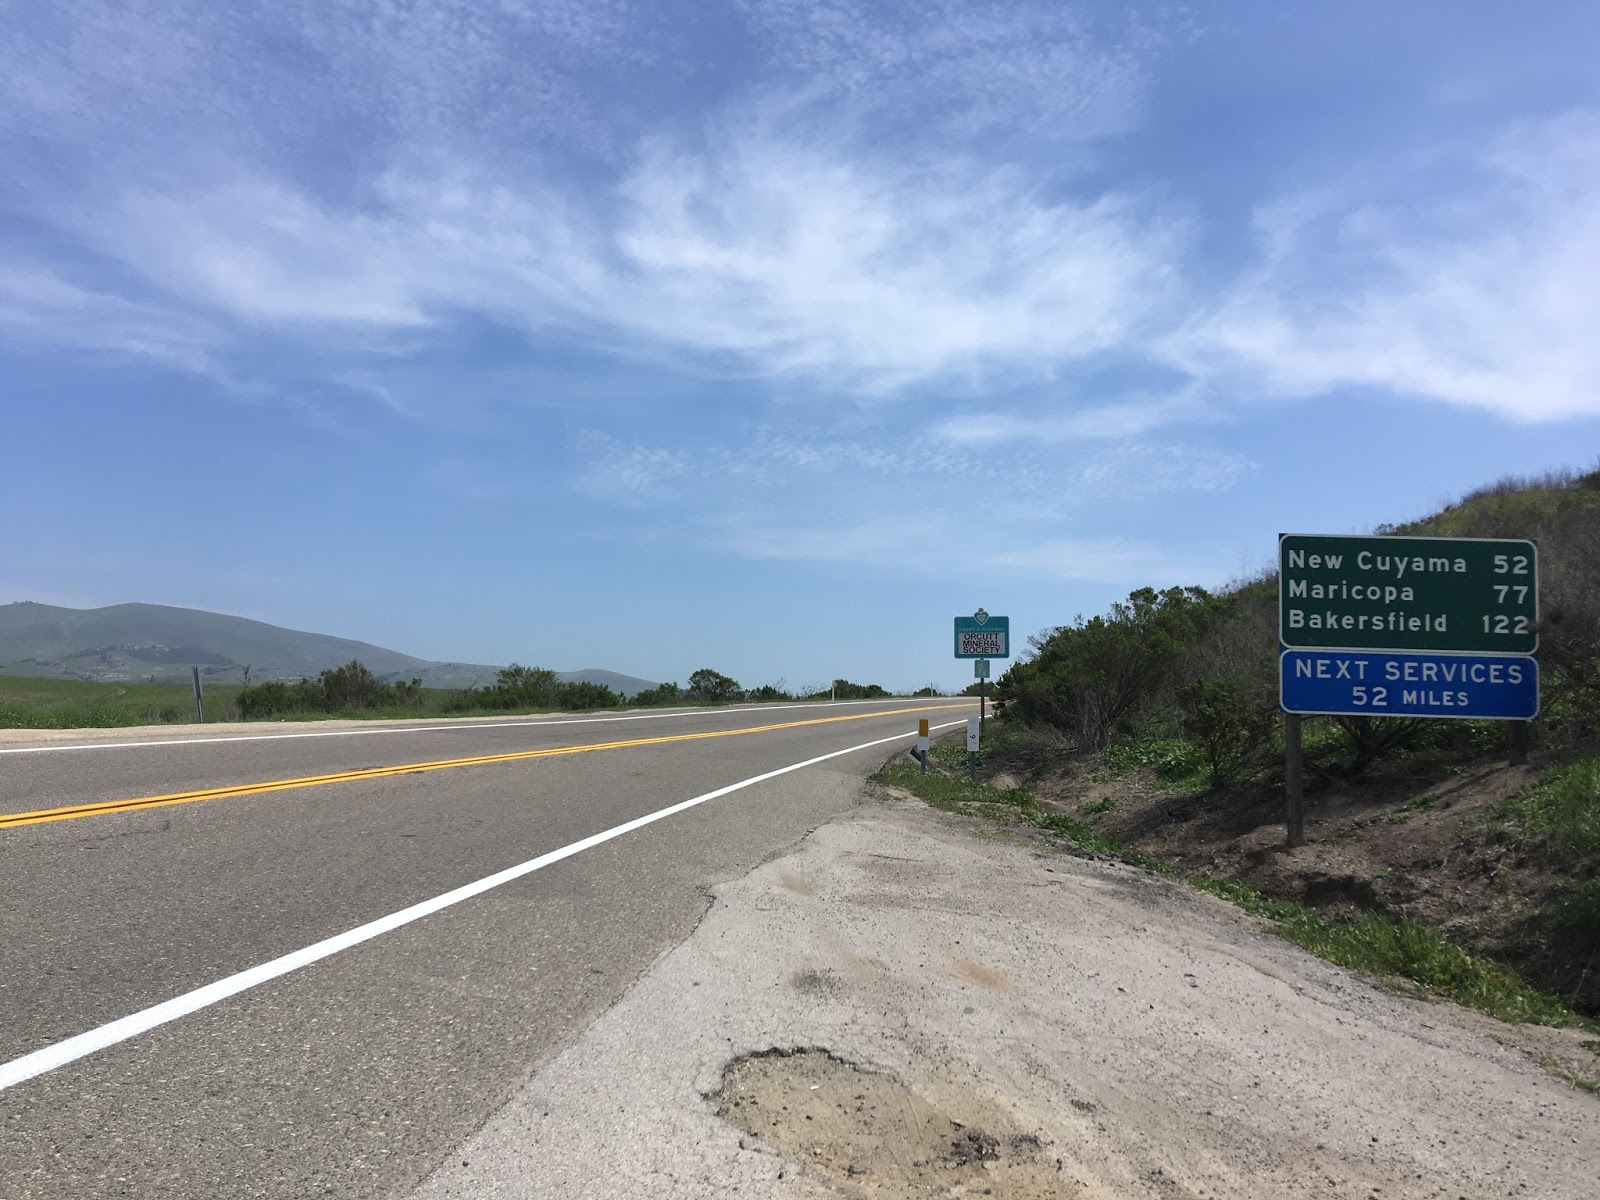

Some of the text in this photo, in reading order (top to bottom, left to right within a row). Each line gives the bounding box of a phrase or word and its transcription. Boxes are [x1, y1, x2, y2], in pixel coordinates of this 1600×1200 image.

[1288, 549, 1529, 578] New Cuyama 52
[1288, 579, 1529, 604] Maricopa 77
[1289, 609, 1529, 634] Bakersfield 122
[1296, 659, 1523, 684] NEXT SERVICES
[1352, 686, 1469, 706] 52 MILES
